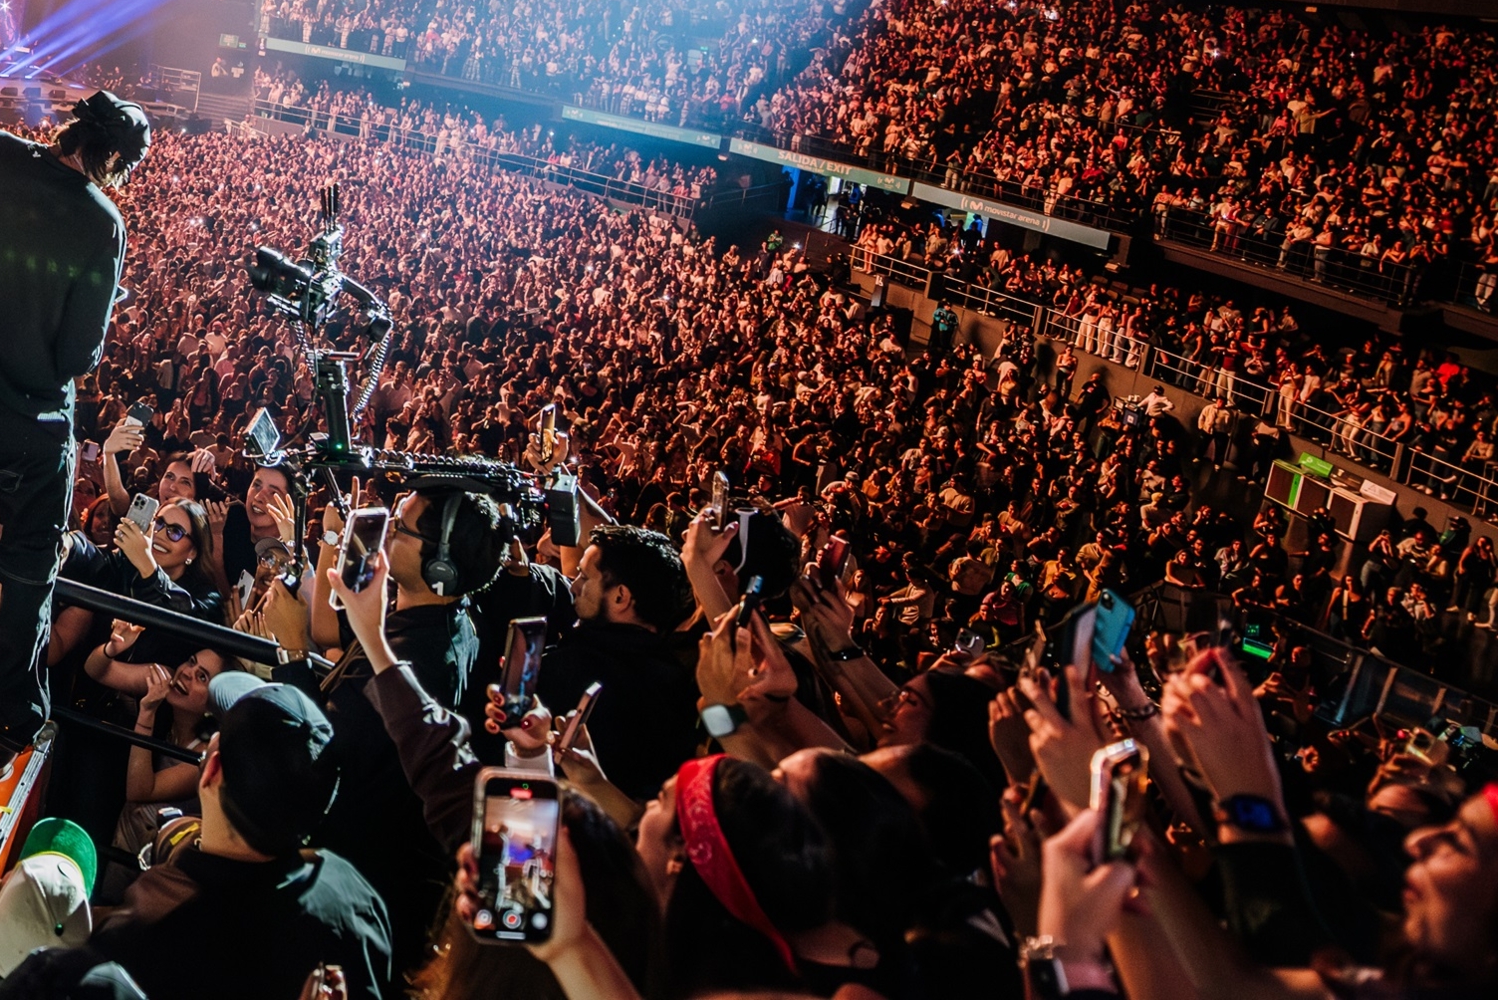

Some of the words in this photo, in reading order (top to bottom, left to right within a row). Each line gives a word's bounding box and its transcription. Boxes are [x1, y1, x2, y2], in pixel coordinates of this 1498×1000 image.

[778, 151, 817, 167] SALIDA
[826, 163, 852, 175] EXIT
[984, 205, 1018, 219] movistar
[1018, 213, 1040, 226] arena
[432, 581, 443, 596] 1
